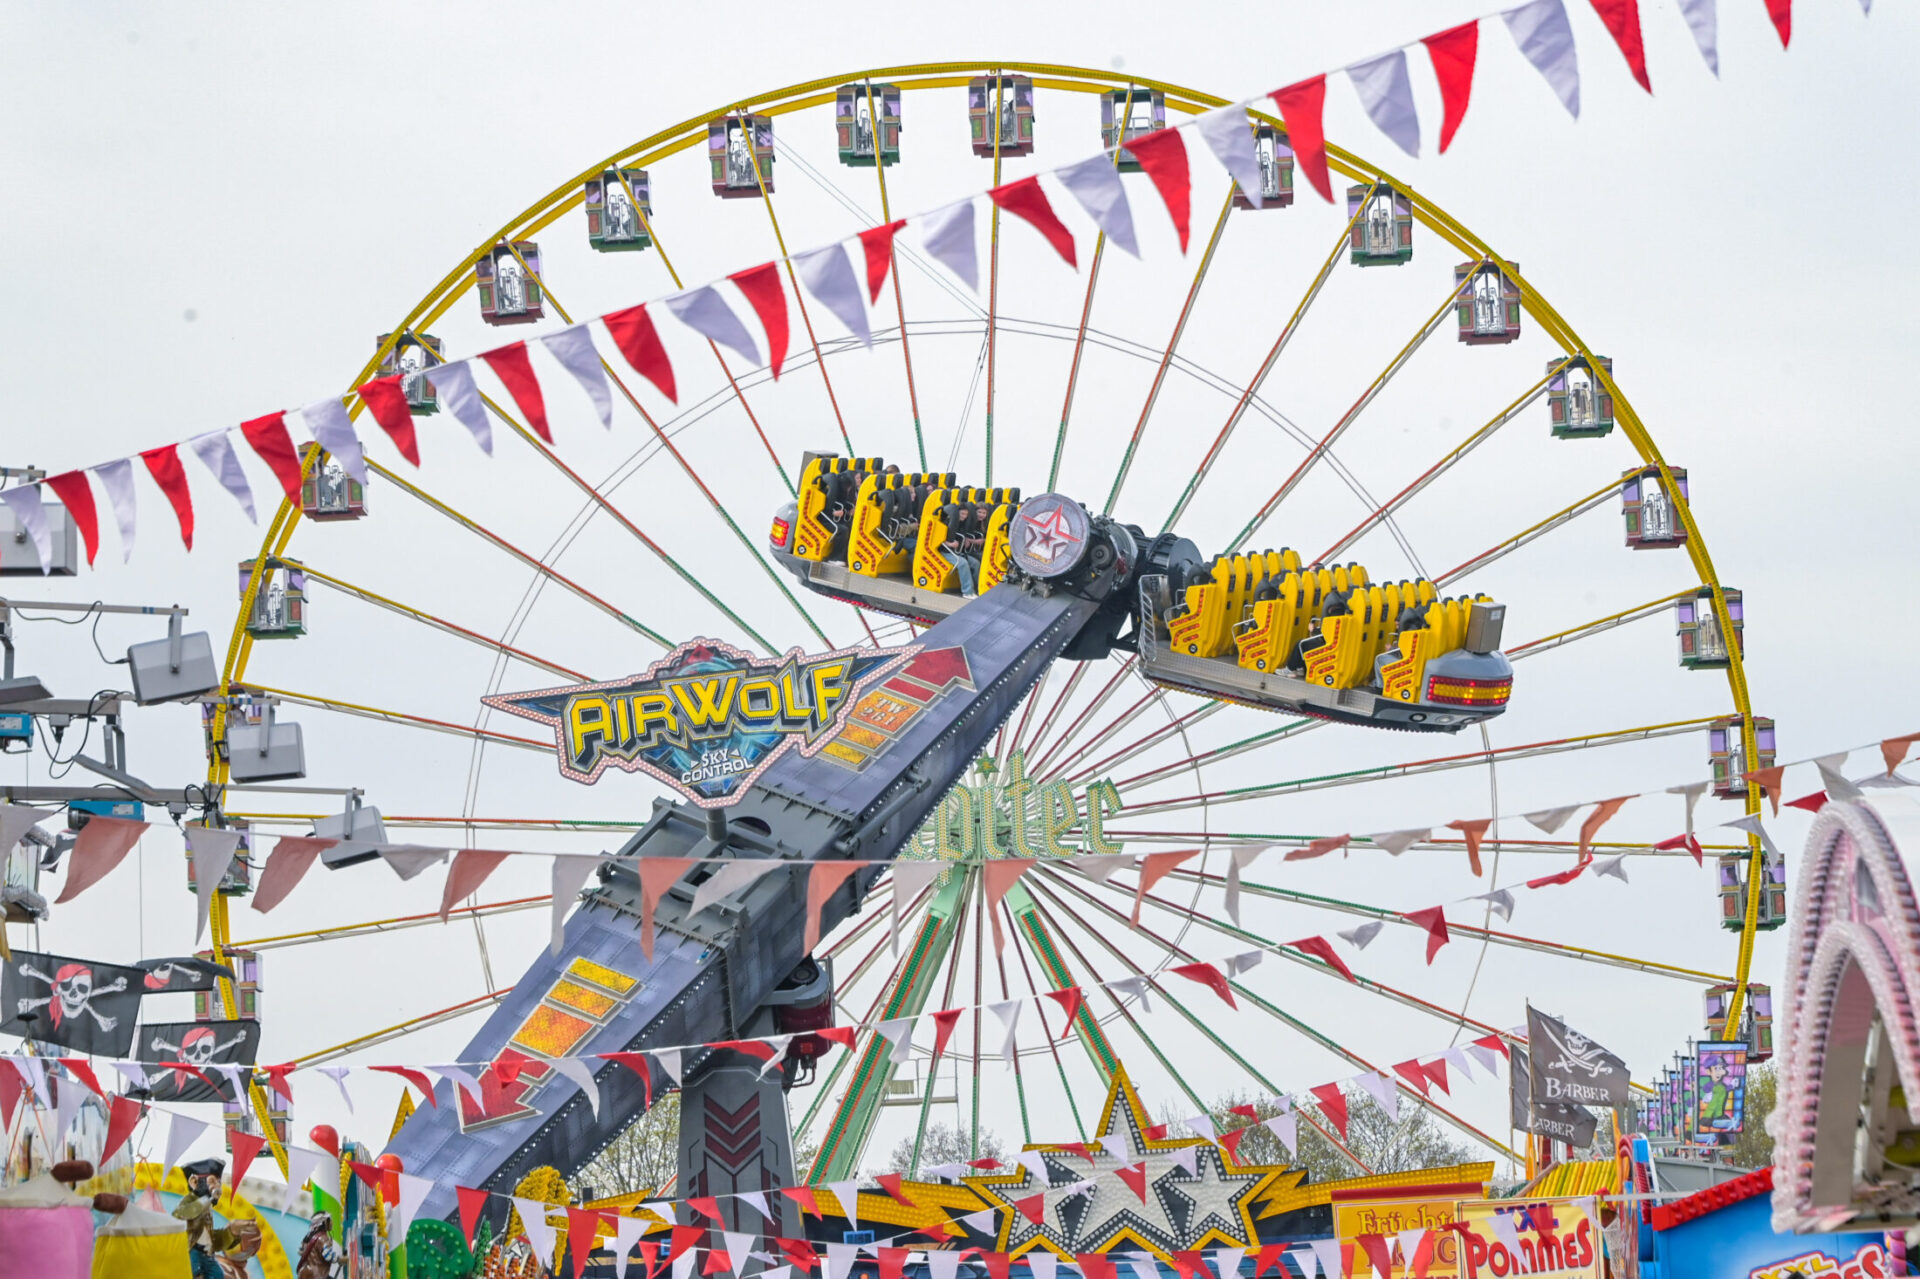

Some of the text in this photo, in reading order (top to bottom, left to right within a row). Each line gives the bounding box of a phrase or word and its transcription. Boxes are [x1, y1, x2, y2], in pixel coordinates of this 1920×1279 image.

[569, 663, 846, 762] AIRWOLF
[876, 697, 907, 713] TW
[681, 757, 755, 785] CONTROL
[701, 748, 729, 767] SKY
[897, 748, 1125, 889] piter
[1544, 1076, 1611, 1102] BARBER
